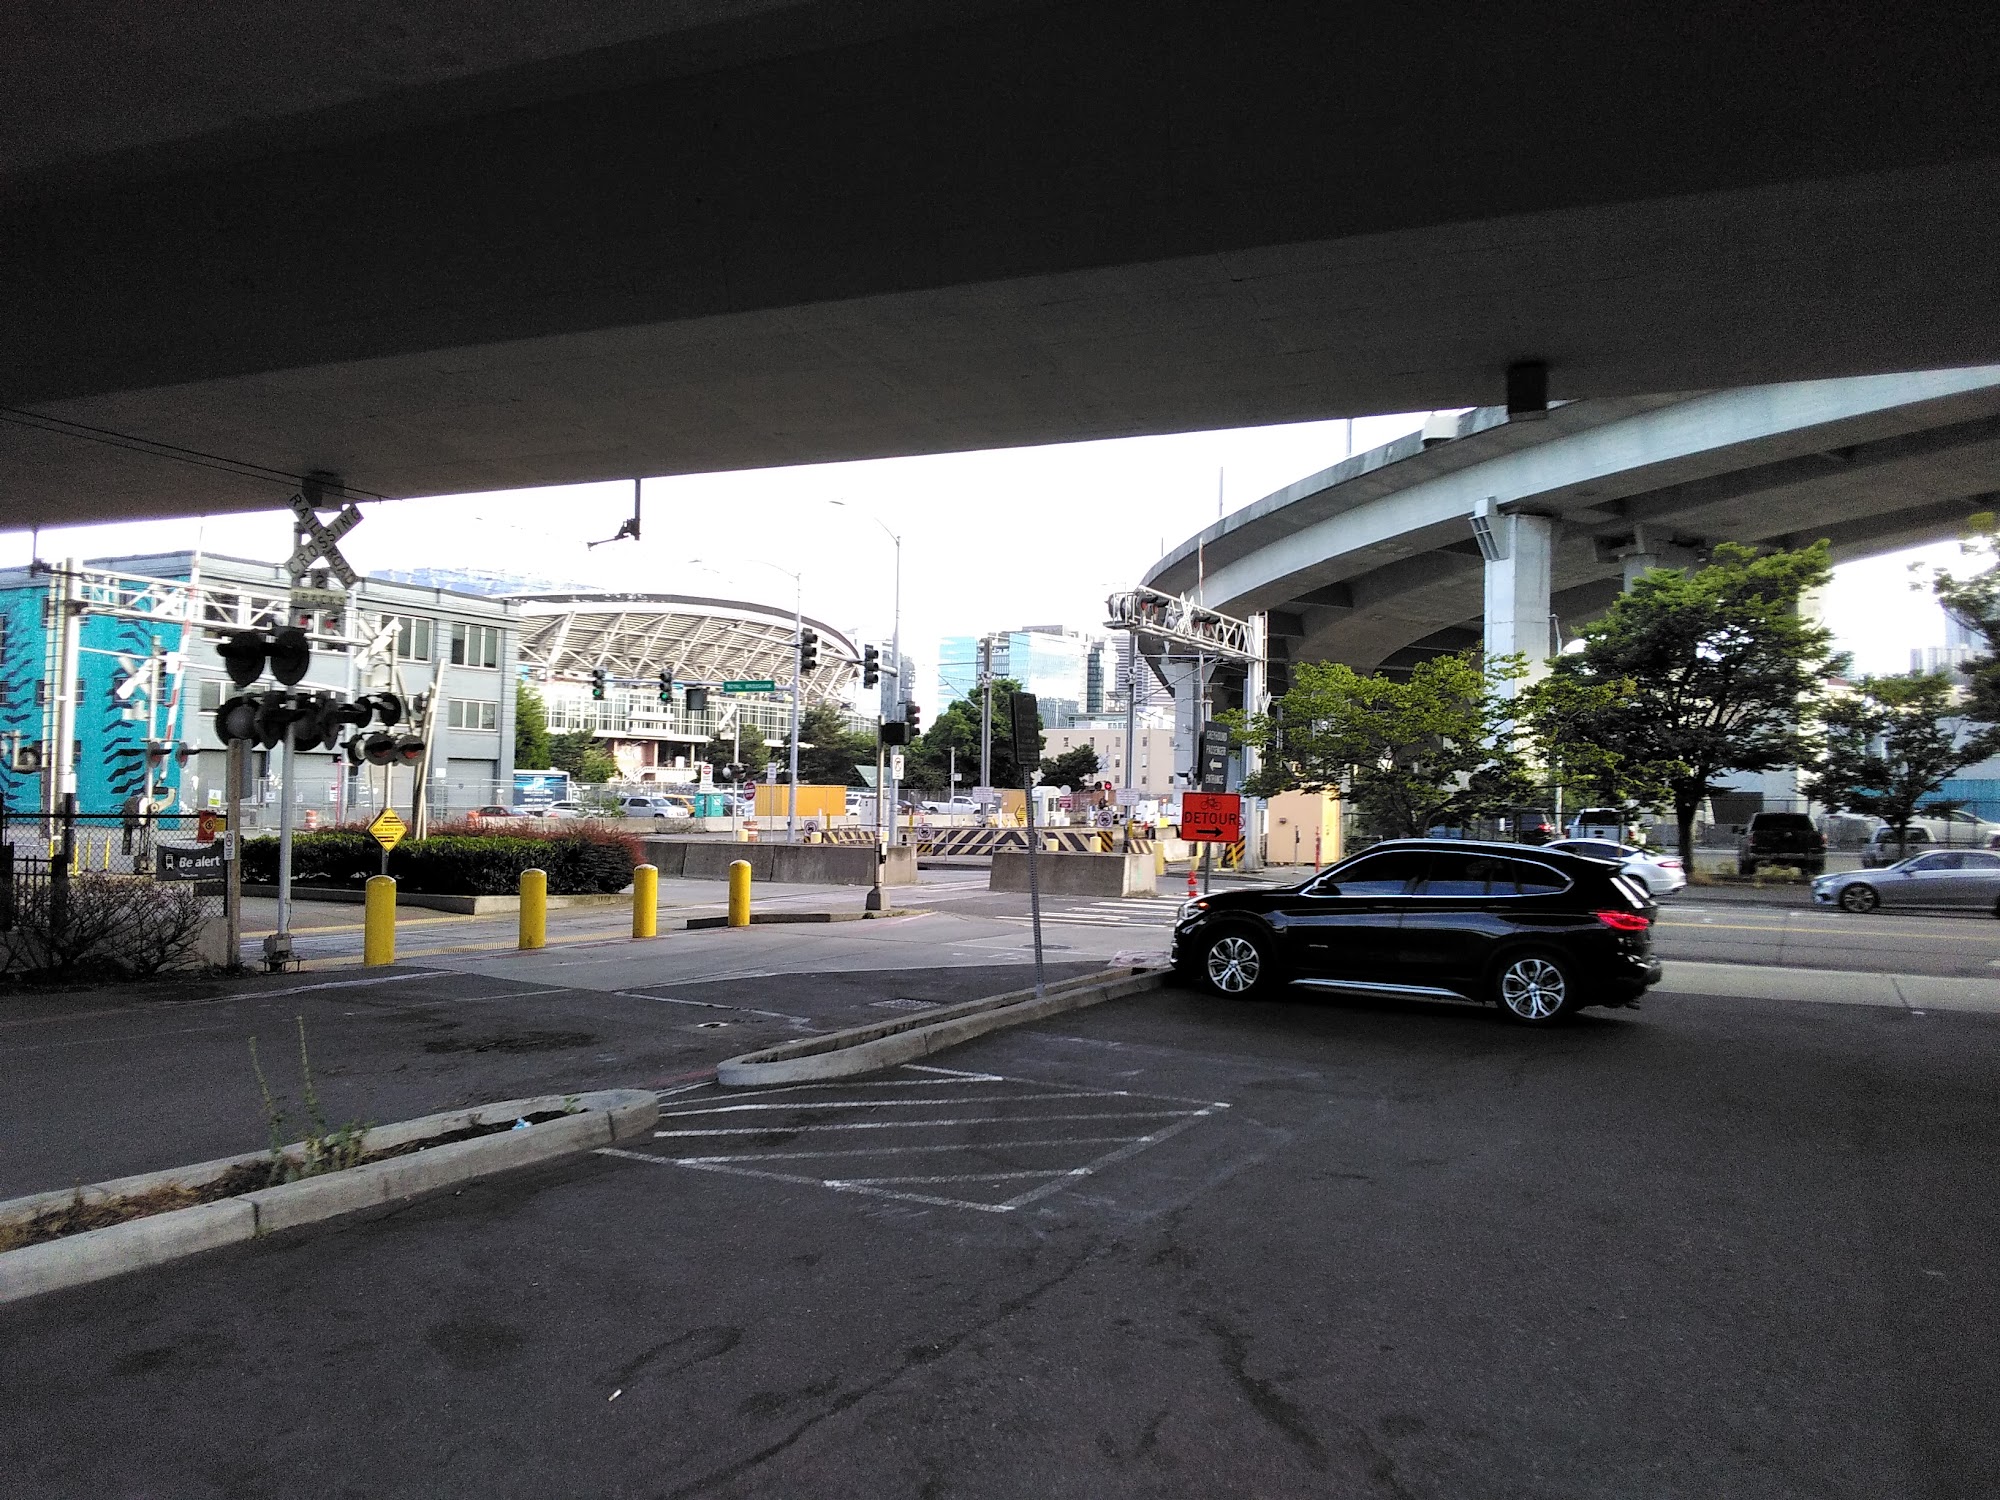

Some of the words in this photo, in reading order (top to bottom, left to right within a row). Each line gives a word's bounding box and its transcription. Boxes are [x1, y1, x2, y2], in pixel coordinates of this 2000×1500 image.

[288, 506, 361, 575] CROSSING
[1206, 730, 1228, 742] GREYHOUND
[1205, 744, 1227, 756] PASSENGER
[1205, 774, 1224, 784] ENTRANCE
[1184, 811, 1238, 826] DETOUR
[179, 856, 193, 868] Be
[195, 855, 221, 868] alert
